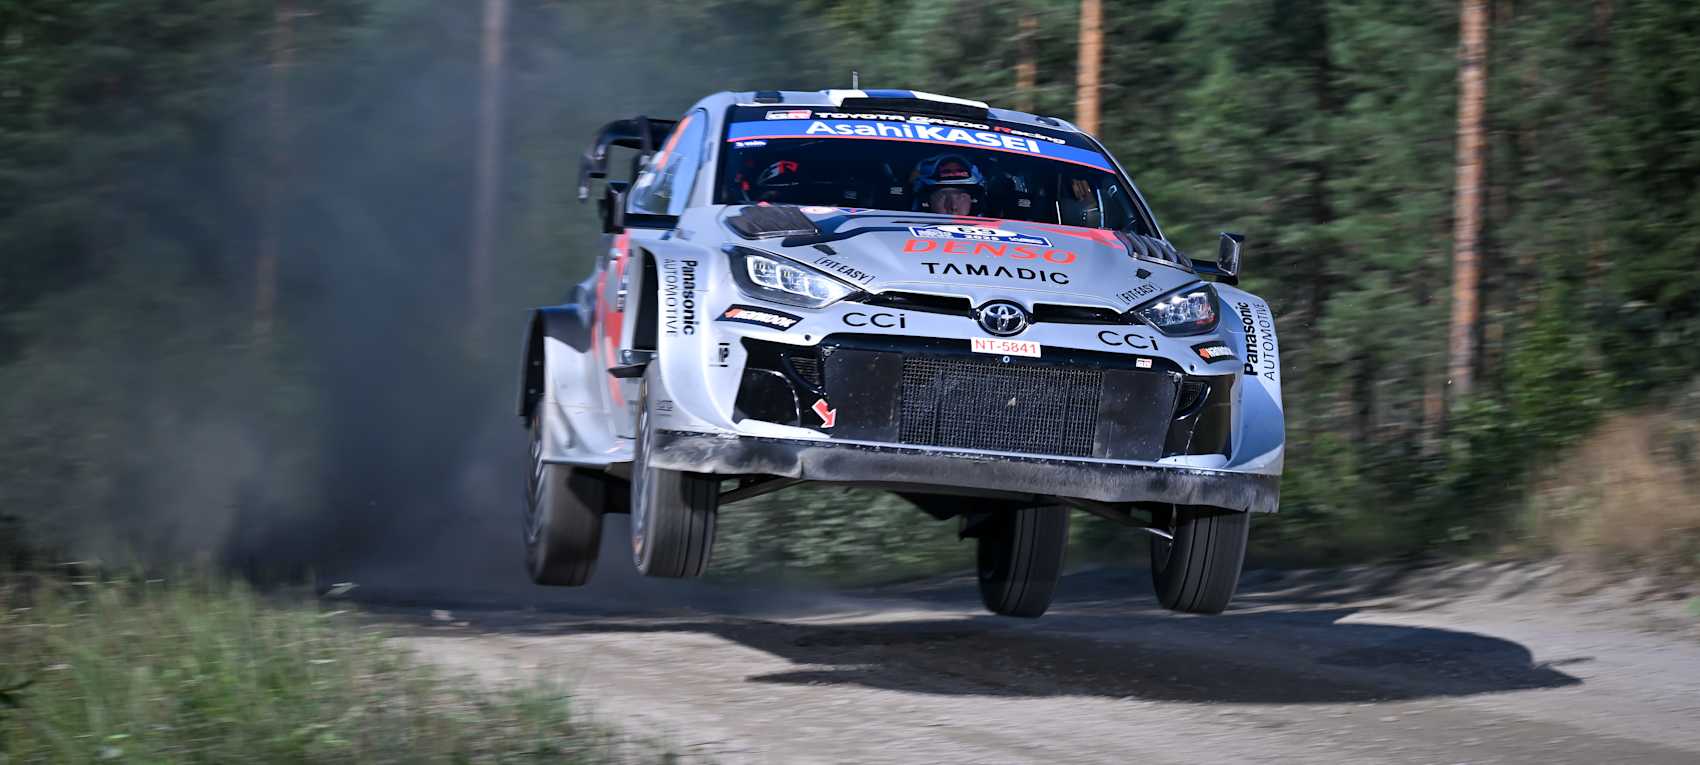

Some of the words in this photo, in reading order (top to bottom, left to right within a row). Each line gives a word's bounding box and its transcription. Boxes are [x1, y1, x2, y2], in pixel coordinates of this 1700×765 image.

[814, 111, 905, 121] TOYOTA
[906, 115, 990, 130] GAZOO
[993, 124, 1066, 145] Racing
[903, 239, 1077, 265] DENSO
[921, 262, 1070, 285] TAMADIC
[681, 260, 700, 335] Panasonic
[975, 339, 1037, 354] NT-5841
[1235, 302, 1258, 376] Panasonic
[1253, 303, 1275, 381] AUTOMOTIVE
